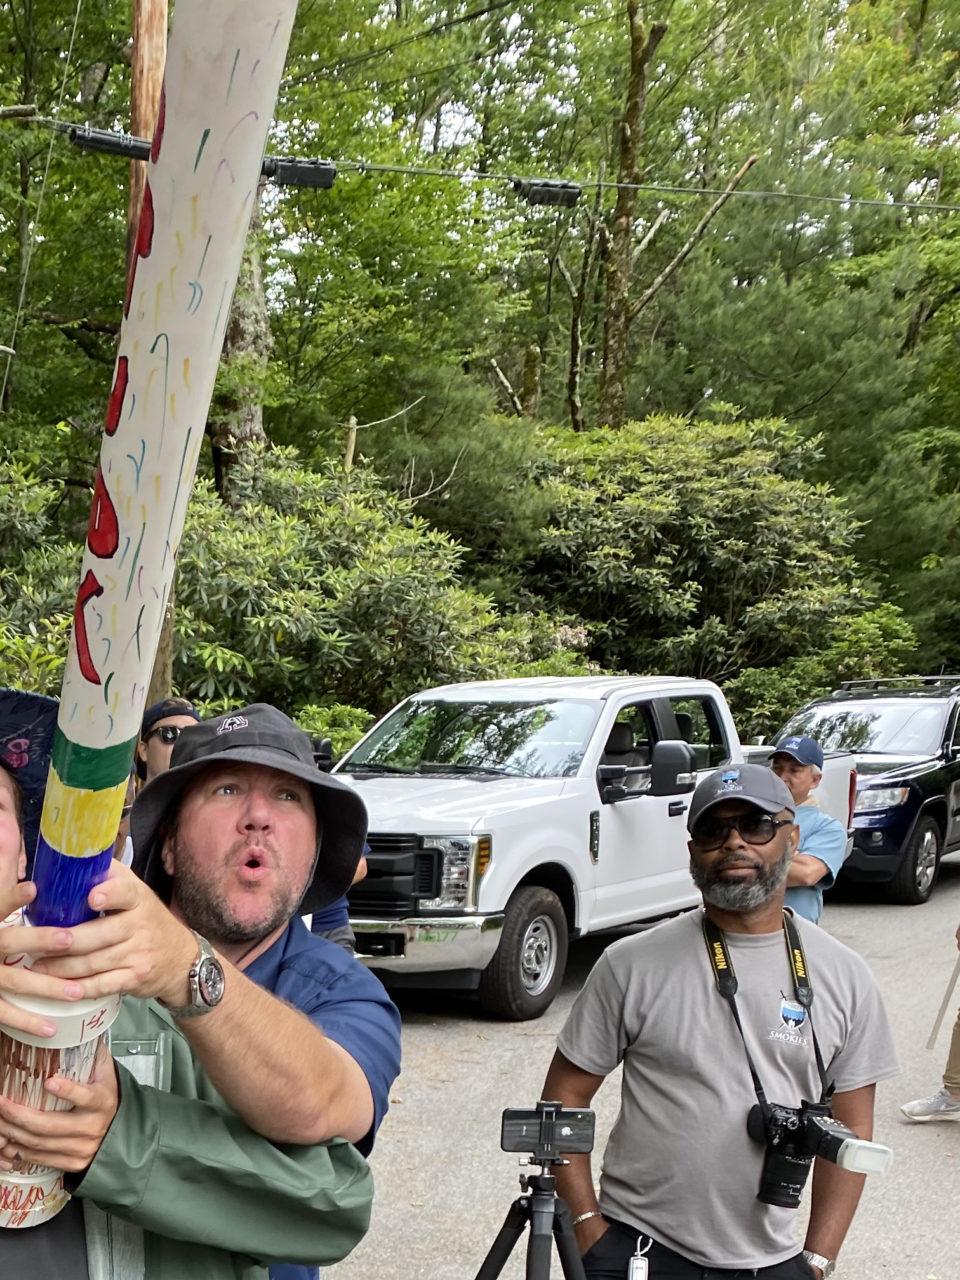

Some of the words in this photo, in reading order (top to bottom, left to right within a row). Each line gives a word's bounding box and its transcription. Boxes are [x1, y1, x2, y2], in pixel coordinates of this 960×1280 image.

[713, 941, 728, 970] Nikon
[793, 949, 806, 978] Nikon
[769, 1030, 808, 1046] SMOKIES
